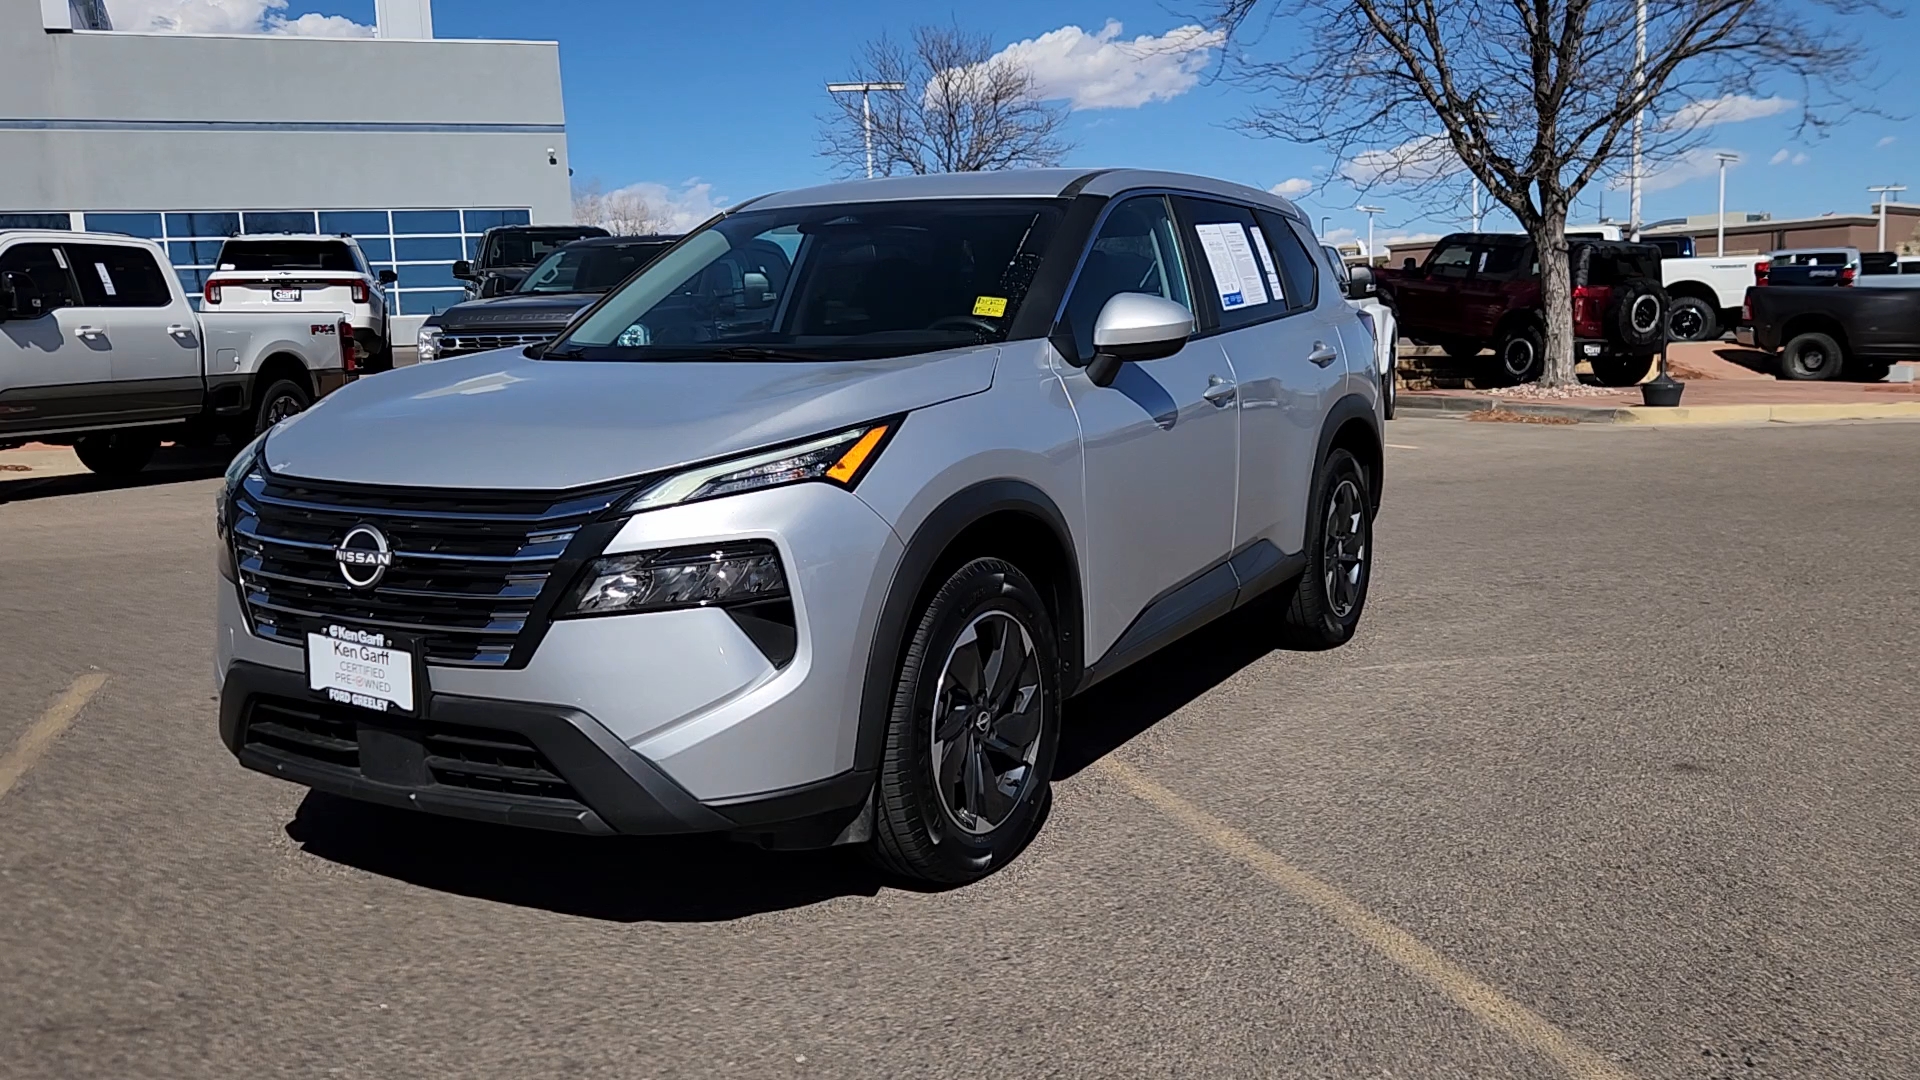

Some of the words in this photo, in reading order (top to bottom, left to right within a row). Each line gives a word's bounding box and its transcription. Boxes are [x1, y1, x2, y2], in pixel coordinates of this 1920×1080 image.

[273, 289, 300, 299] Garff
[311, 324, 334, 335] FX4
[335, 550, 391, 564] NISSAN
[338, 626, 358, 641] Ken
[358, 630, 384, 647] Garff
[333, 641, 358, 659] Ken
[360, 647, 389, 665] Garff
[340, 661, 385, 679] CERTIFIED
[329, 689, 351, 703] FORD
[352, 694, 388, 711] GREELEY
